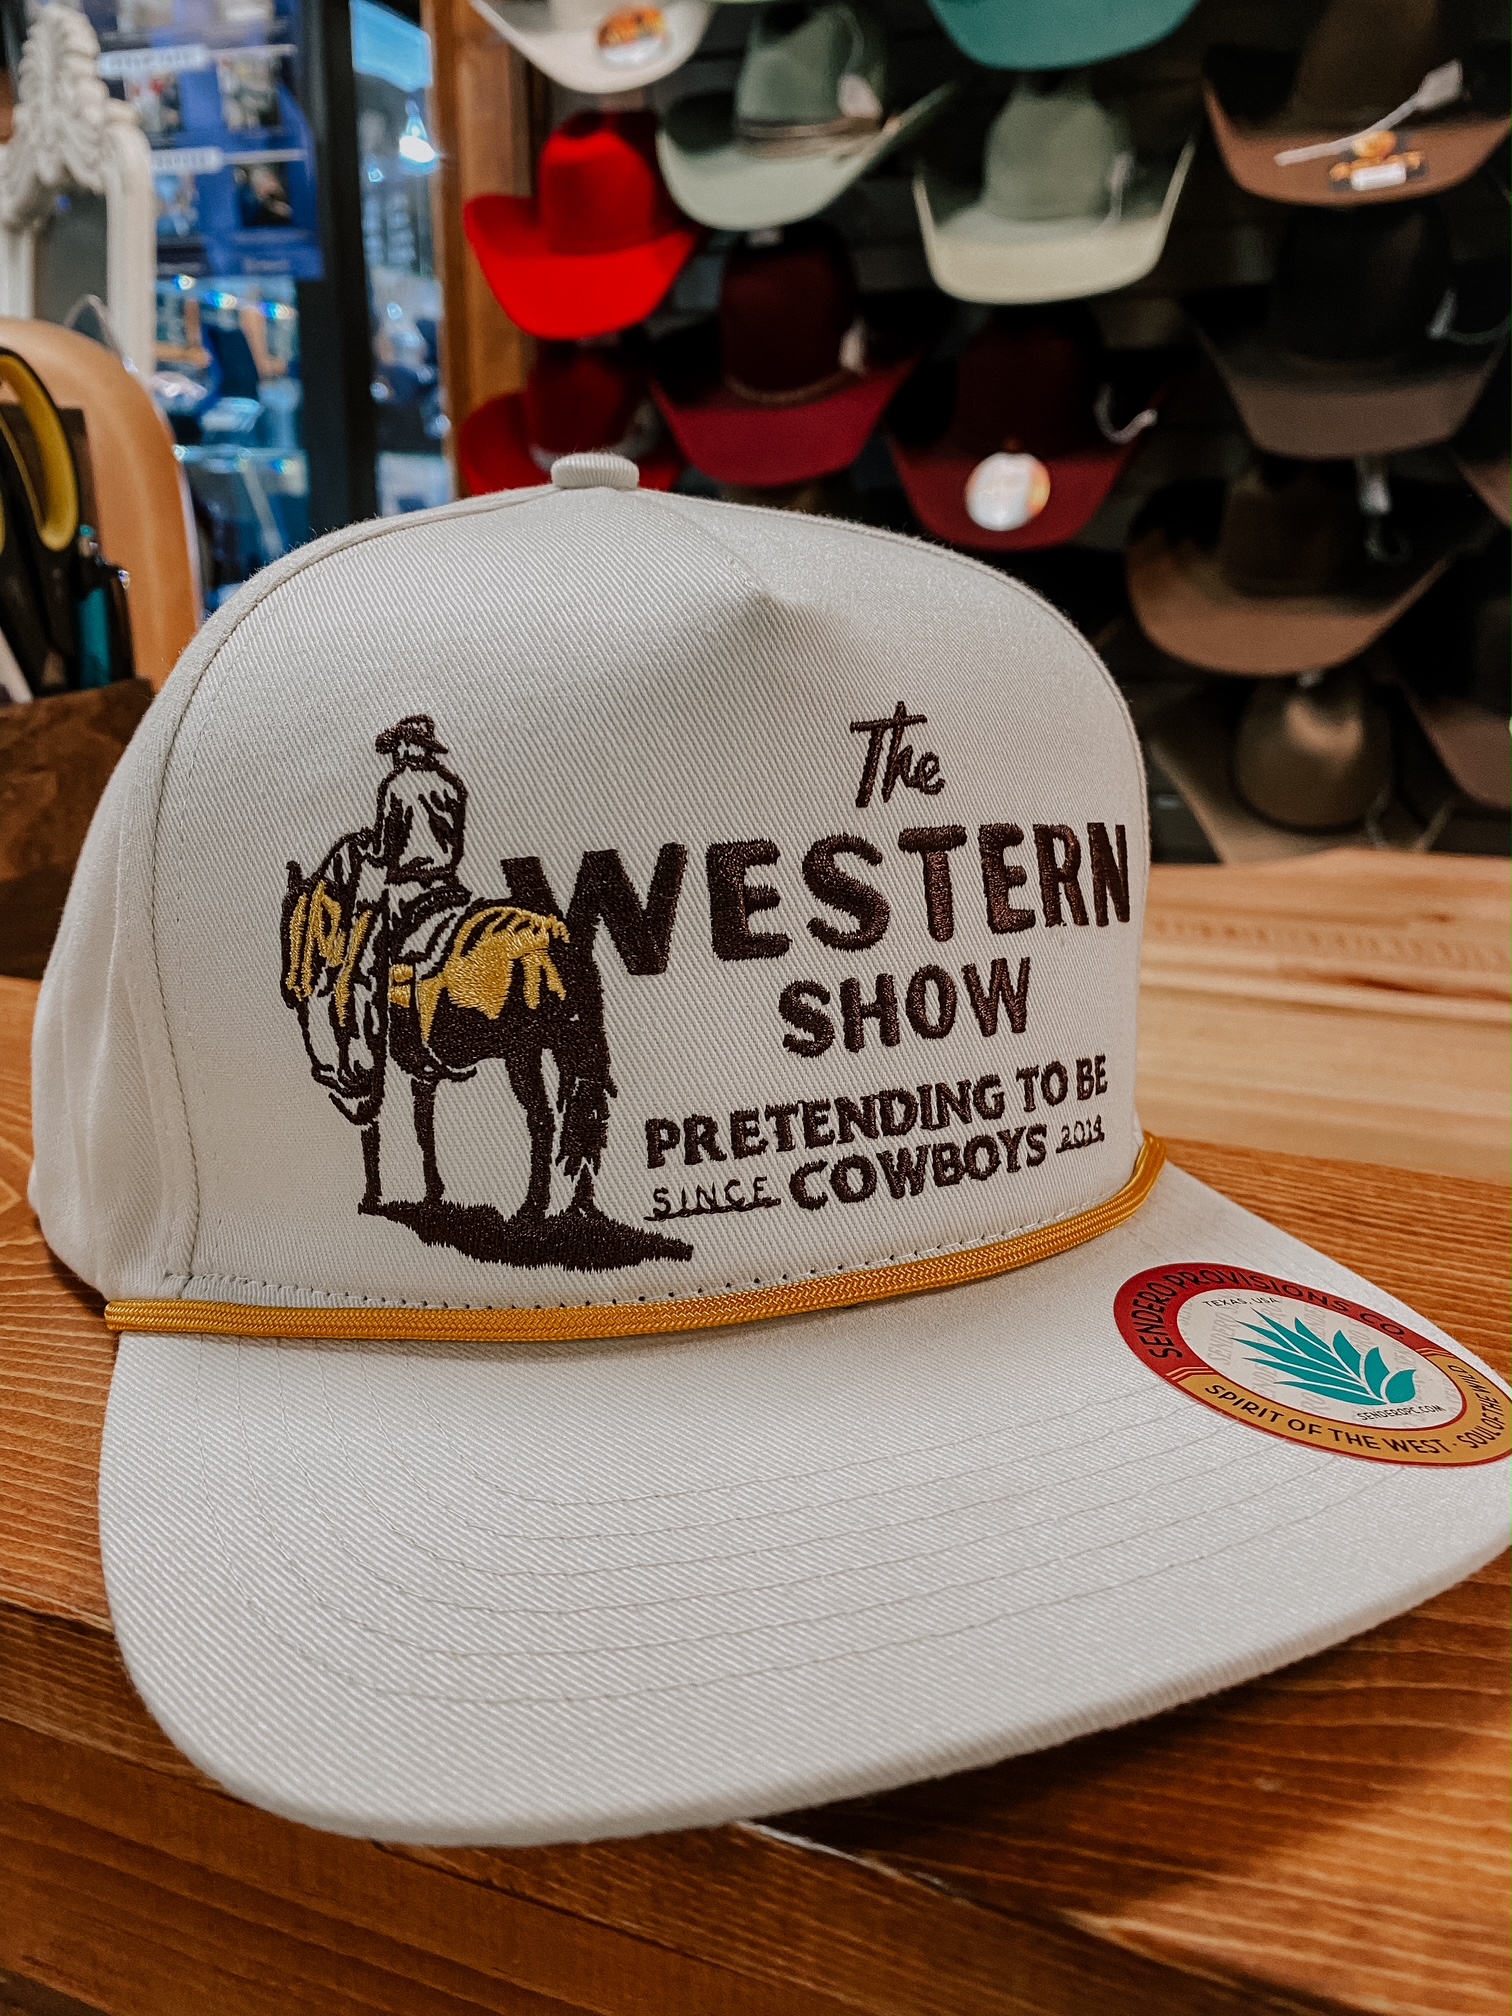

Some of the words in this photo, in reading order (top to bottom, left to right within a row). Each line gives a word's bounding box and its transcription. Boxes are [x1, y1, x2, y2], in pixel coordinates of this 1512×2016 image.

[850, 701, 946, 808] The
[501, 821, 1132, 976] WESTERN
[778, 957, 1031, 1059] SHOW
[644, 1073, 1006, 1169] PRETENDING
[1015, 1060, 1069, 1107] TO
[1076, 1053, 1108, 1101] BE
[649, 1176, 774, 1219] SINCE
[789, 1123, 1048, 1211] COWBOYS
[1131, 1281, 1183, 1359] SENDERO
[1163, 1269, 1350, 1313] PROVISIONS
[1250, 1296, 1281, 1305] USA
[1356, 1404, 1446, 1421] SENDEROPC.COM
[1447, 1364, 1491, 1394] WILD
[1474, 1392, 1504, 1417] THE
[1205, 1384, 1285, 1423] SPIRIT
[1287, 1418, 1322, 1435] OF
[1328, 1428, 1381, 1449] THE
[1382, 1437, 1453, 1454] WEST
[1456, 1424, 1502, 1449] SOUL
[1481, 1411, 1506, 1430] OF
